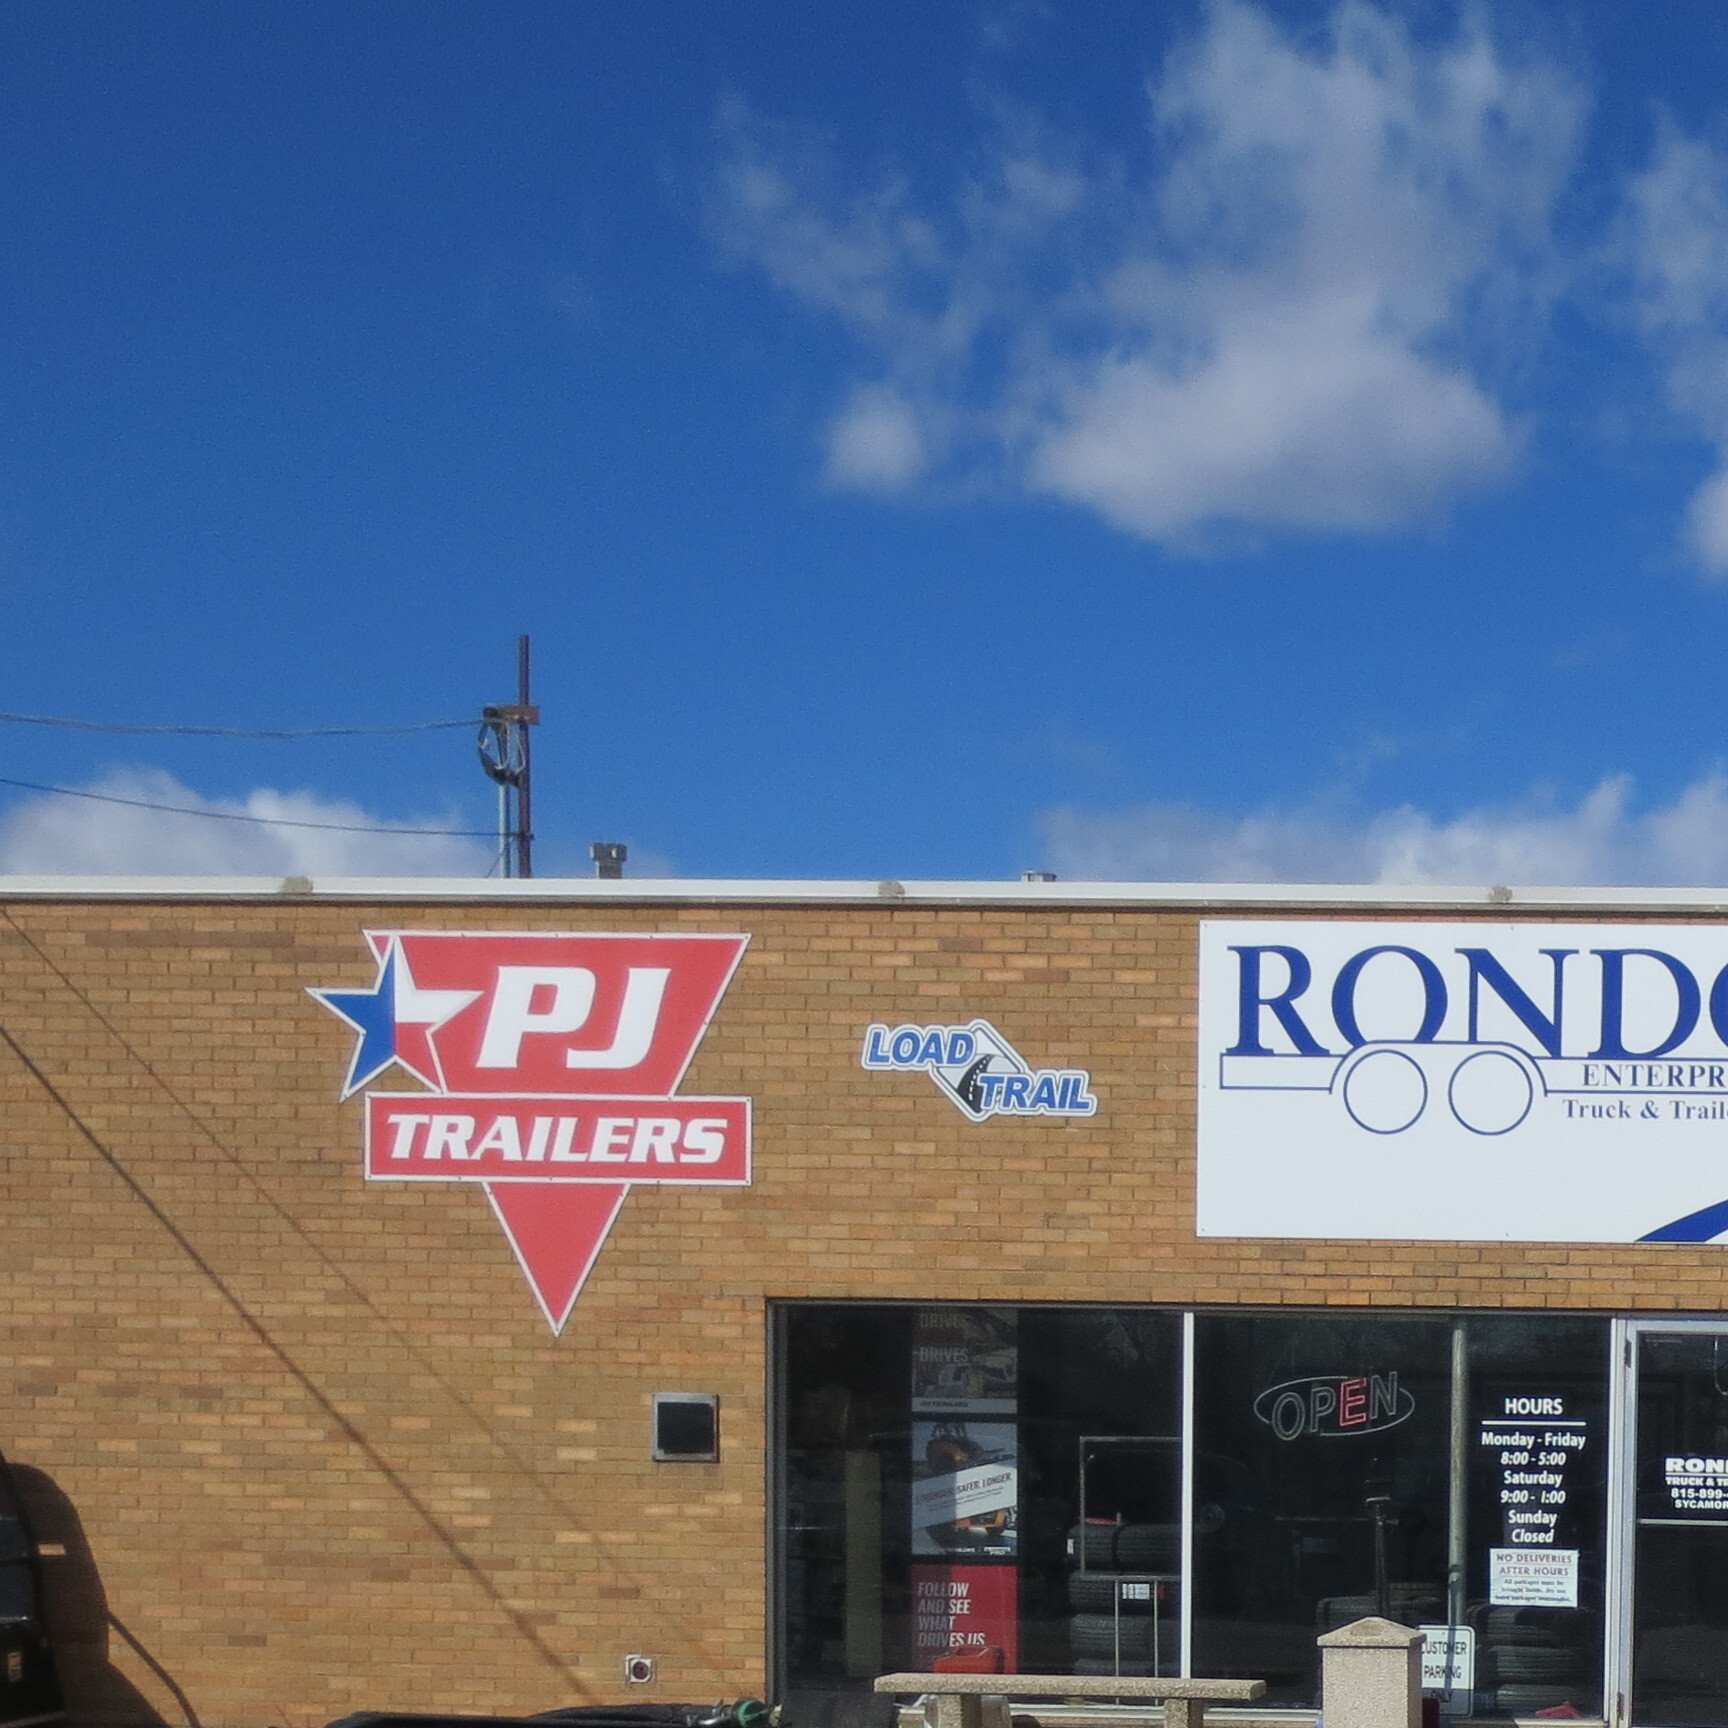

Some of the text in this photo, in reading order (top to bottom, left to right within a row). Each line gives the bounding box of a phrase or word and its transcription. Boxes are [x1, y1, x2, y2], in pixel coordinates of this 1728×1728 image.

[476, 966, 672, 1070] PJ
[868, 1031, 975, 1065] LOAD
[979, 1075, 1090, 1110] TRAIL
[1562, 1099, 1631, 1119] Truck
[1640, 1099, 1660, 1120] &
[387, 1113, 730, 1165] TRAILERS
[1272, 1371, 1398, 1441] OPEN
[1505, 1398, 1563, 1415] HOURS
[1481, 1432, 1535, 1449] Monday
[1544, 1432, 1586, 1450] Friday
[1500, 1451, 1529, 1465] 8:00
[1538, 1452, 1566, 1466] 5:00
[1503, 1470, 1563, 1488] Saturday
[1665, 1477, 1704, 1486] TRUCK
[1706, 1477, 1714, 1486] &
[1500, 1490, 1529, 1503] 9:00
[1541, 1490, 1566, 1504] 1:00
[1508, 1509, 1558, 1527] Sunday
[1511, 1529, 1555, 1543] Closed
[1496, 1553, 1572, 1564] NO DELIVERIES
[1499, 1567, 1569, 1576] AFTER HOURS
[918, 1582, 970, 1597] FOLLOW
[918, 1599, 971, 1614] AND SEE
[918, 1616, 956, 1630] WHAT
[917, 1632, 985, 1647] DRIVES US
